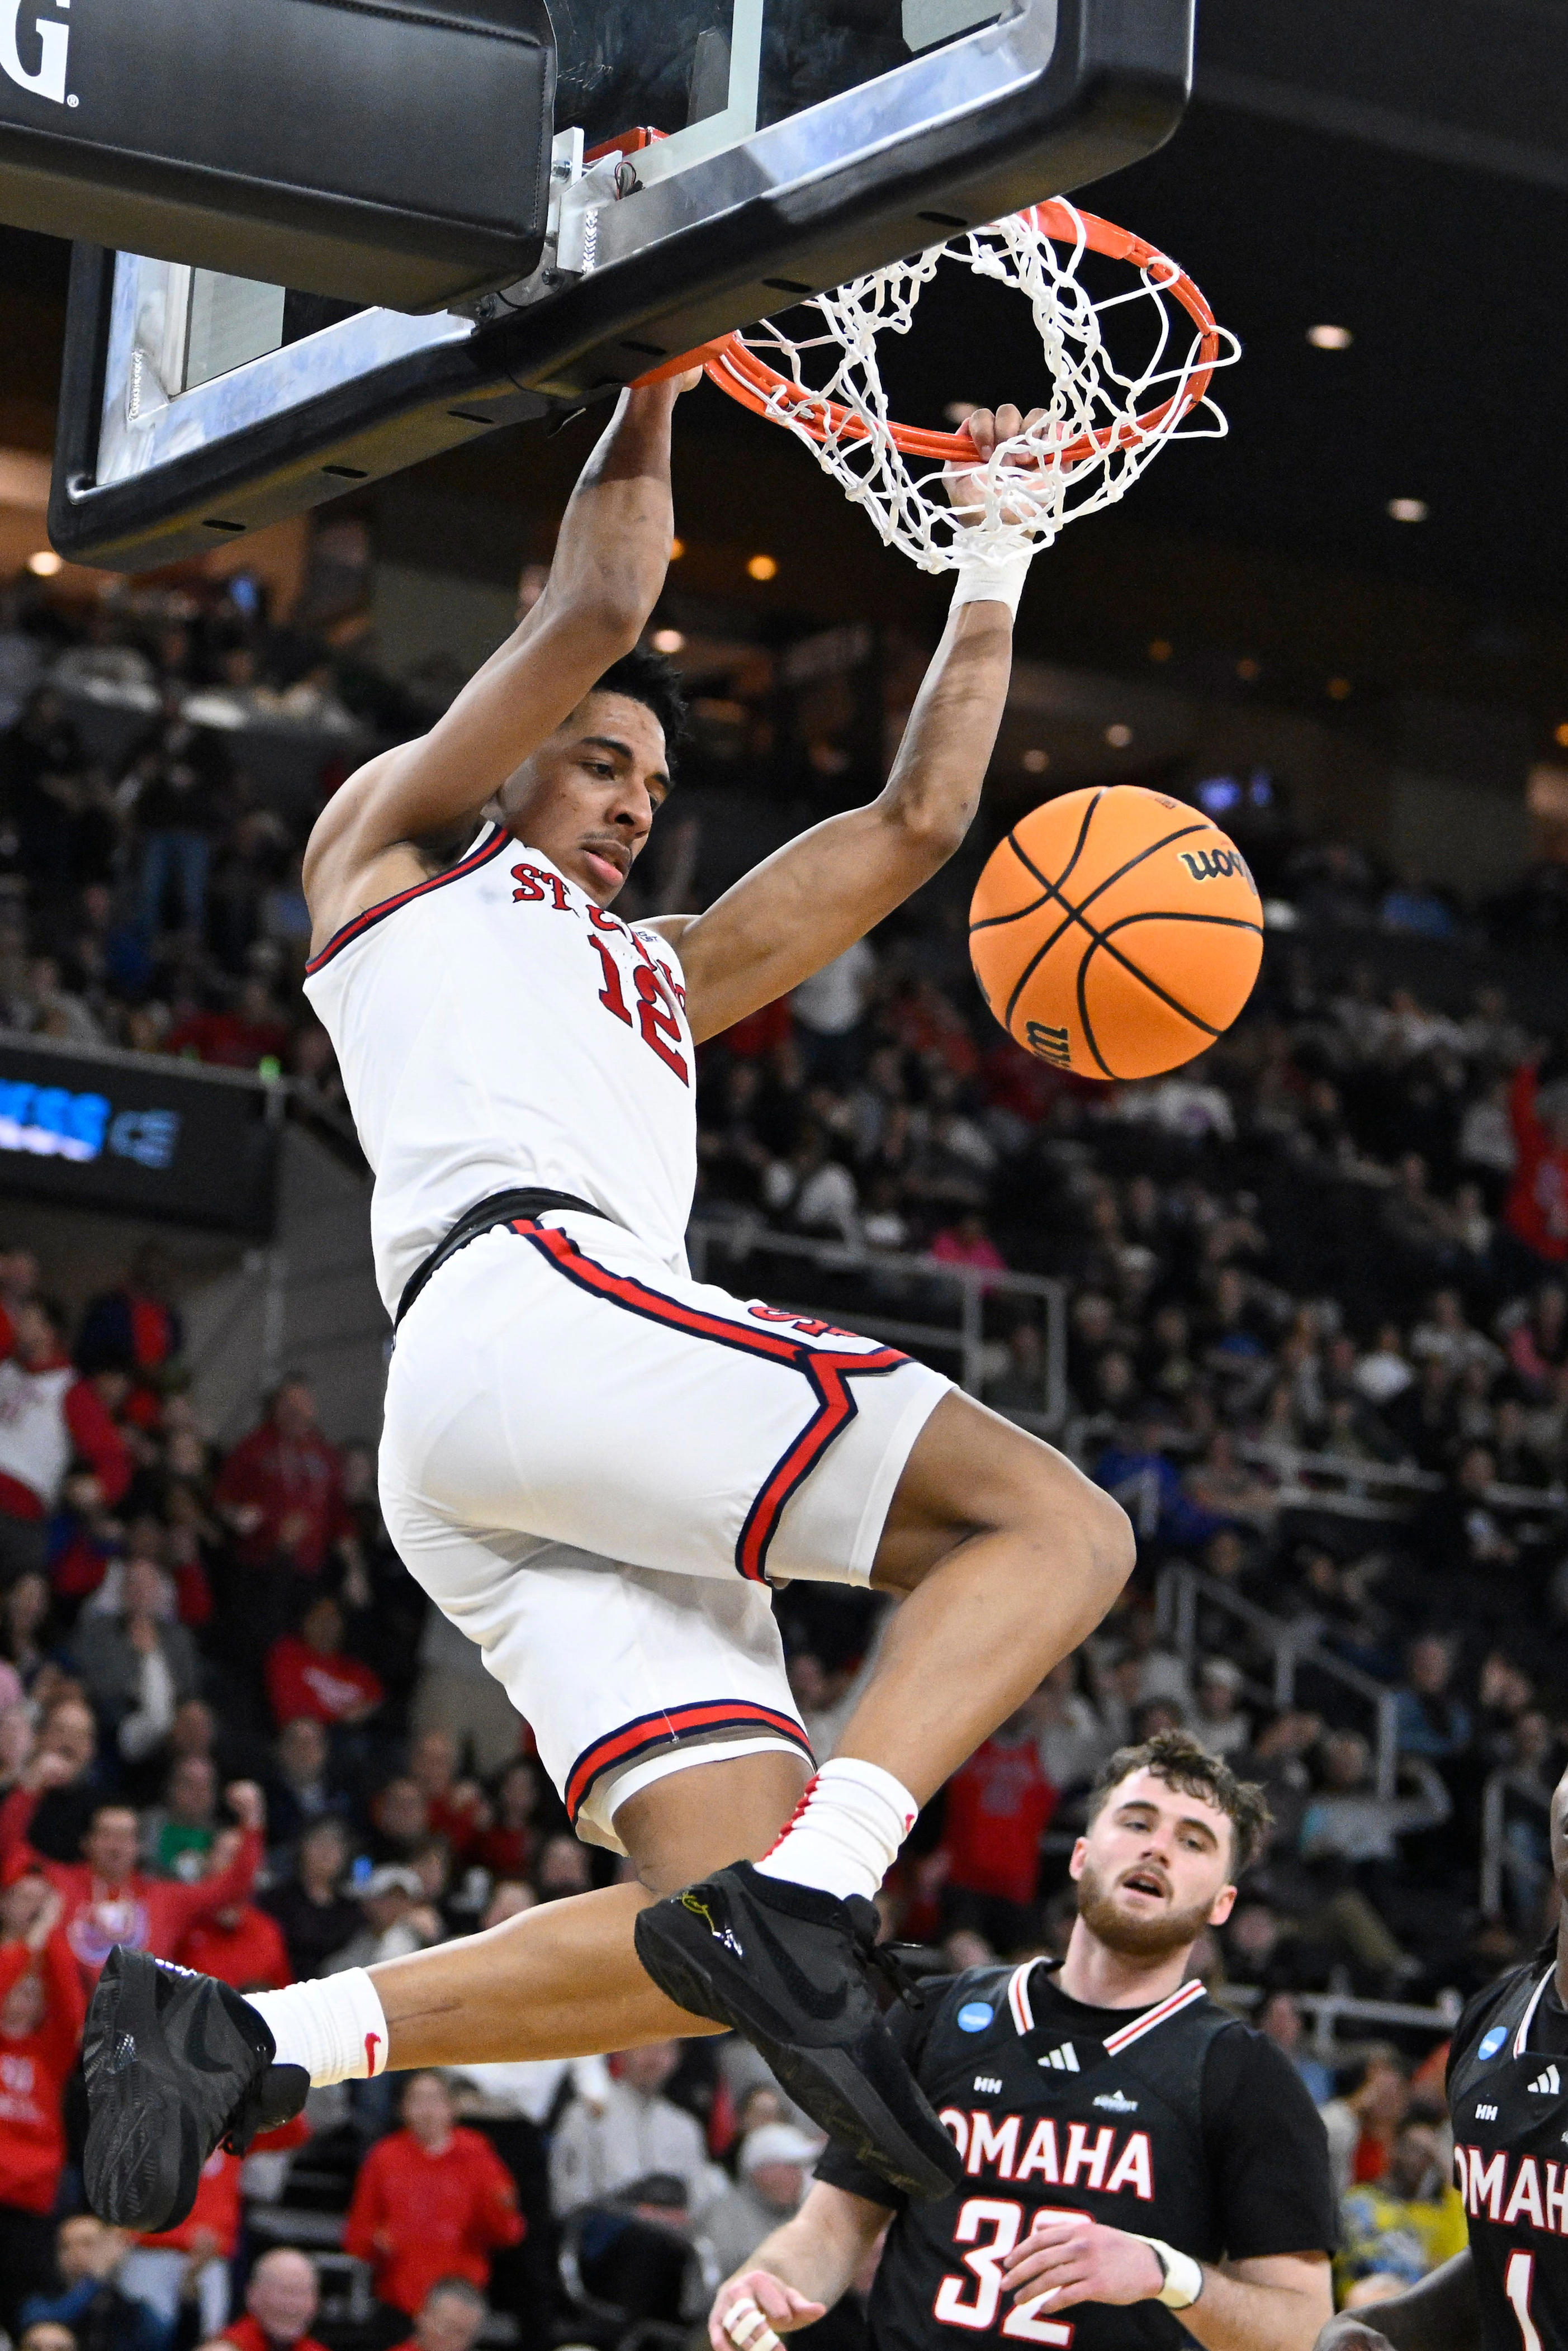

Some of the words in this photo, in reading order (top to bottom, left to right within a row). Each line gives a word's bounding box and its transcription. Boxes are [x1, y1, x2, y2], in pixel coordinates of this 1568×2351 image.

[587, 933, 689, 1088] 12
[973, 2076, 1003, 2094] HH
[1475, 2103, 1498, 2121] HH
[1454, 2143, 1568, 2238] MAH
